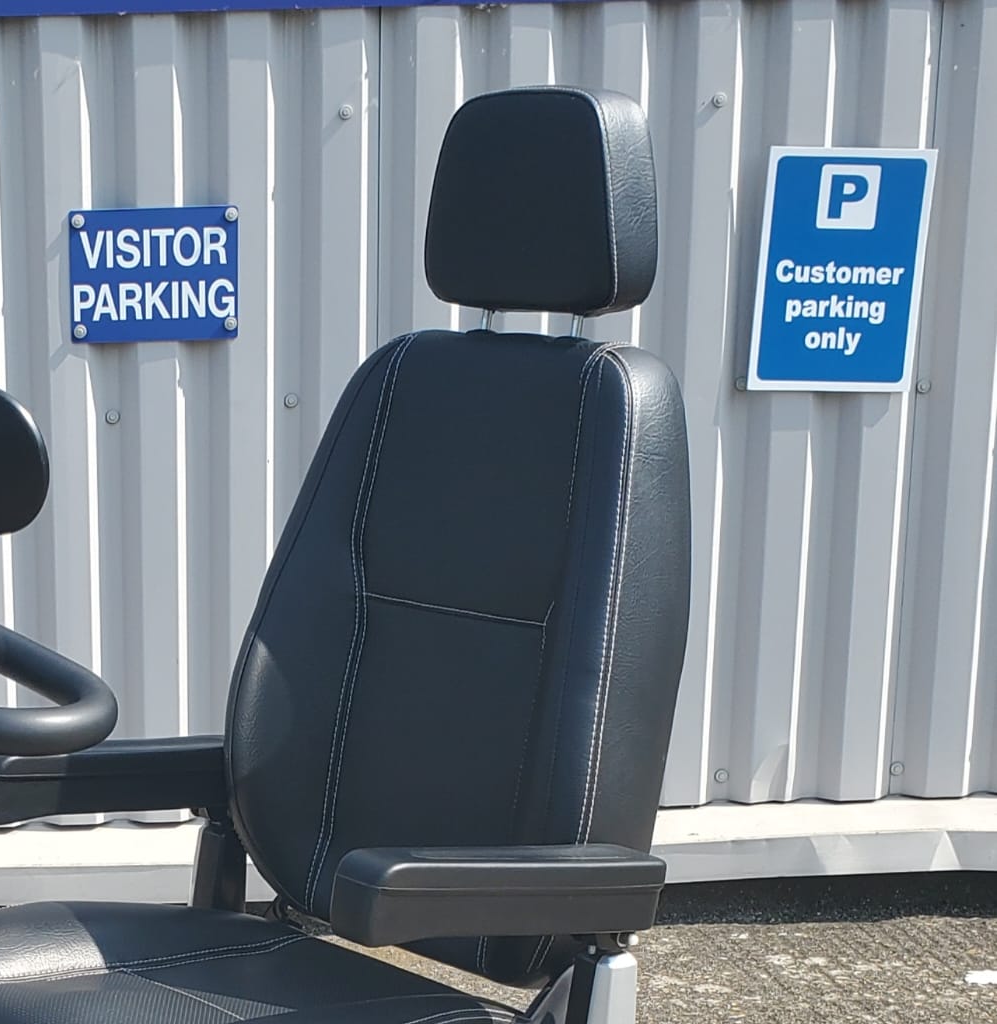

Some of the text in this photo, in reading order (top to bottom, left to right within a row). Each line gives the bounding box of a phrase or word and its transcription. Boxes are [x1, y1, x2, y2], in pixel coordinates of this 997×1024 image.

[826, 174, 869, 219] P
[79, 226, 228, 270] VISITOR
[775, 259, 905, 285] Customer
[73, 278, 236, 323] PARKING
[785, 295, 886, 325] parking
[804, 327, 862, 356] only
